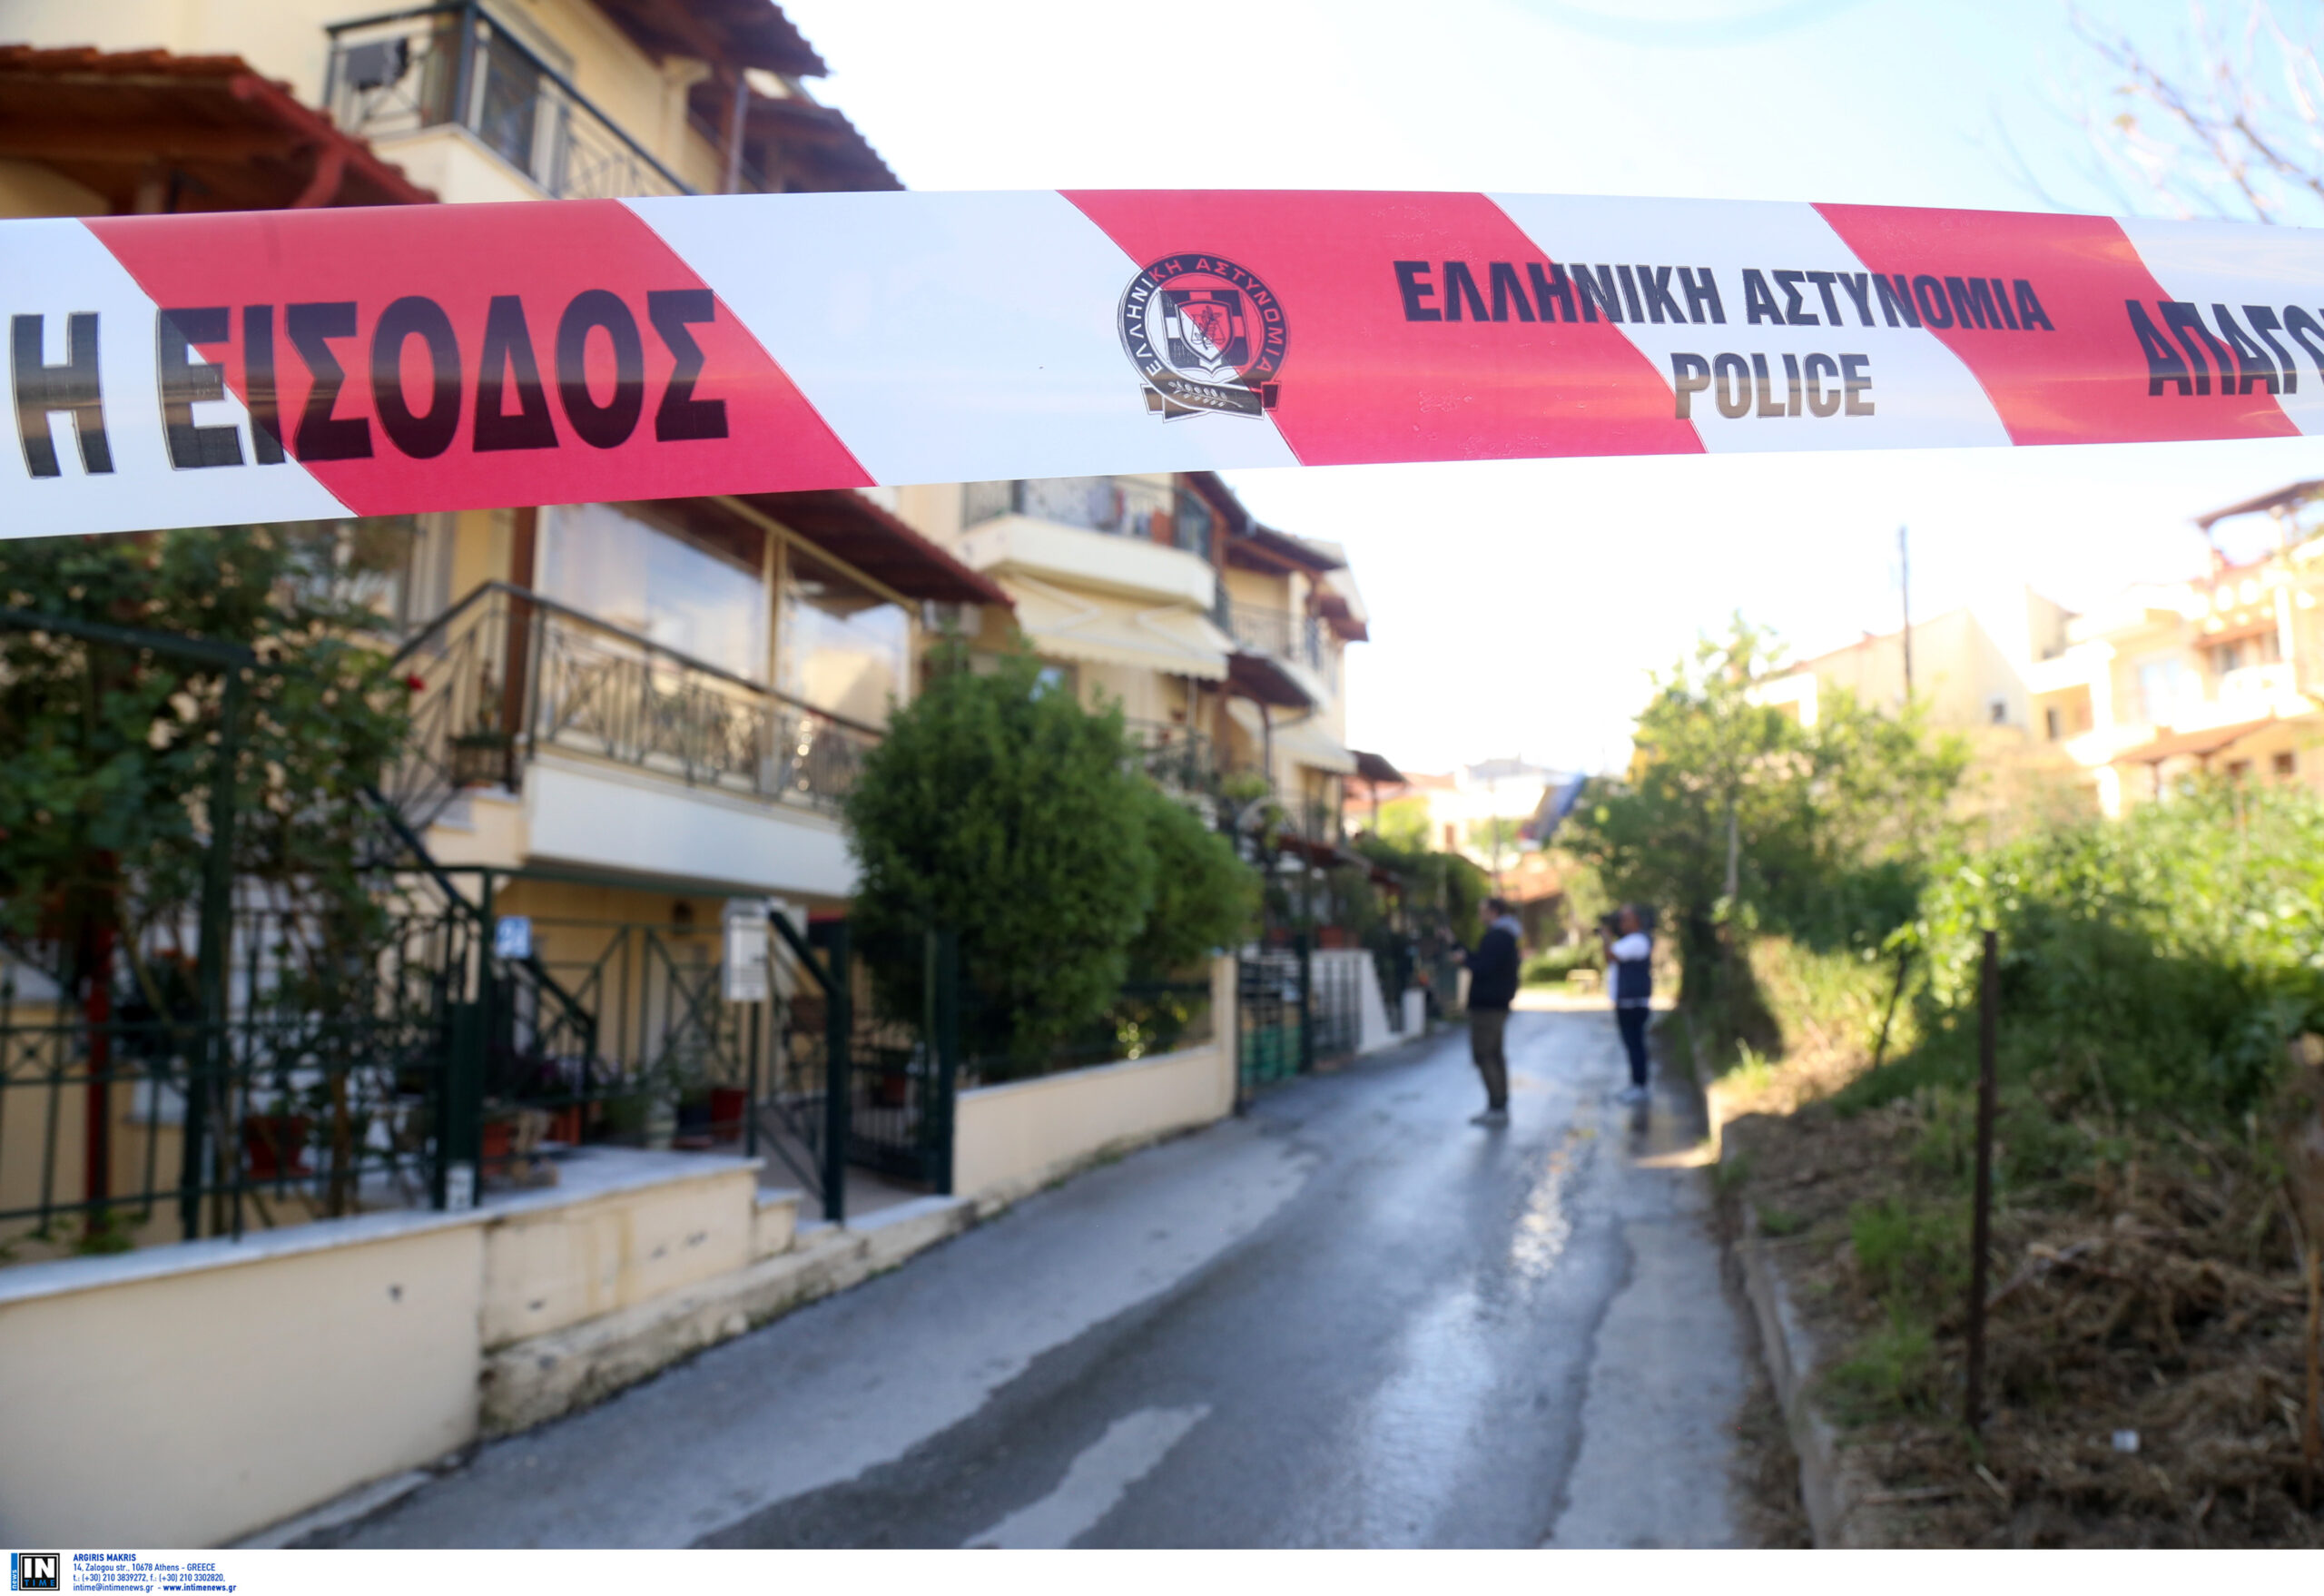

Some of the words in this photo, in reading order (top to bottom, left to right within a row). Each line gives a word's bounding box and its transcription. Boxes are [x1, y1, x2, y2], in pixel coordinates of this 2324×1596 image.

[1127, 260, 1183, 377] ΕΛΛΗΝΙΚΗ
[1196, 258, 1284, 373] ΑΣΤΥΝΟΜΙΑ
[1393, 260, 1727, 325] ΕΛΛΗΝΙΚΗ
[1740, 268, 2056, 331] ΑΣΤΥΝΟΜΙΑ
[11, 310, 115, 478] Η
[155, 288, 729, 471] ΕΙΣΟΔΟΣ
[1669, 352, 1876, 419] POLICE
[2124, 299, 2324, 396] ΑΠΑΓΟ
